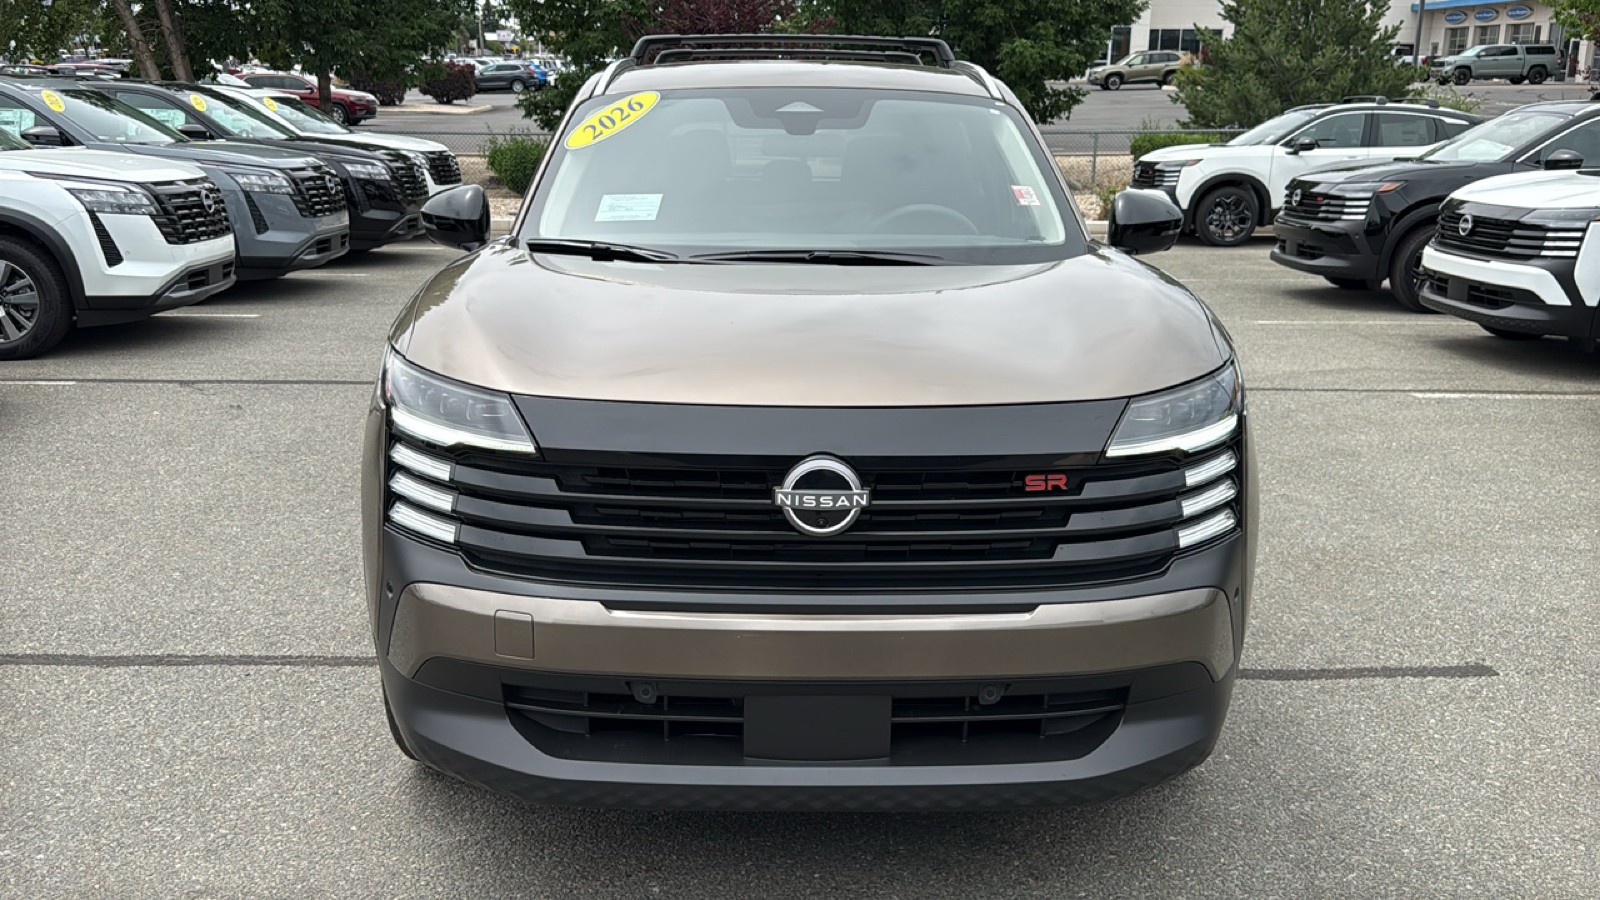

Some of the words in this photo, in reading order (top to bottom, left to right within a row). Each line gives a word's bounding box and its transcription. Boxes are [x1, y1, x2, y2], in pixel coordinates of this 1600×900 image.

[583, 98, 644, 140] 2026
[1024, 474, 1068, 491] SR
[776, 493, 867, 507] NISSAN
